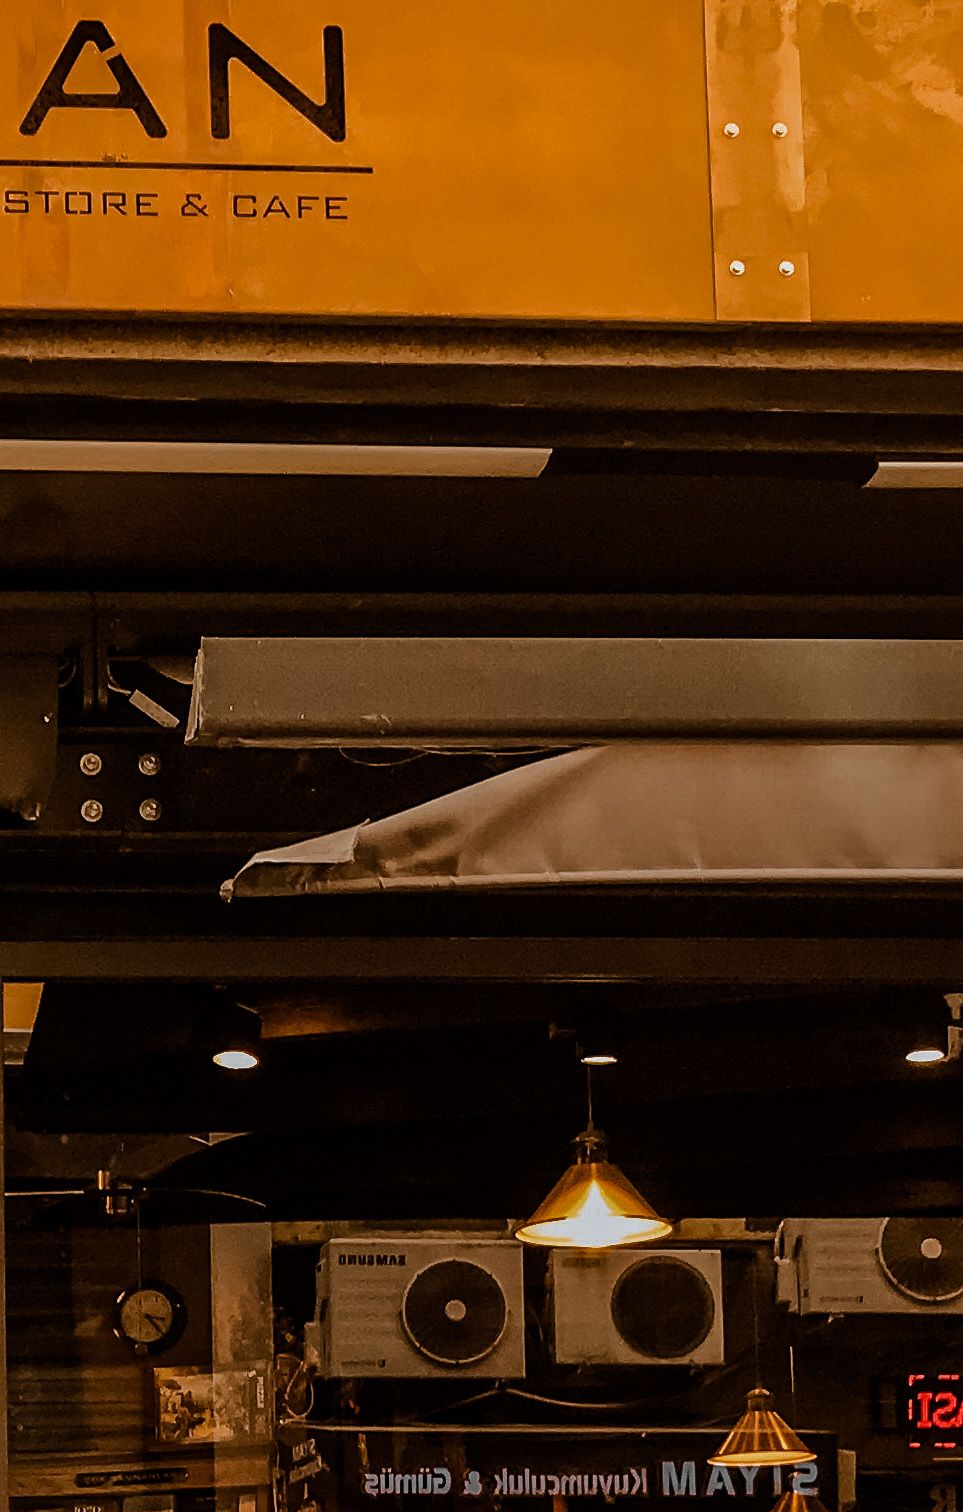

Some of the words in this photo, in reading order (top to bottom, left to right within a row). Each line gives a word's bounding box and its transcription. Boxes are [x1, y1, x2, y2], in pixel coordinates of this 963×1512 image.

[19, 20, 345, 142] AN
[3, 190, 159, 217] STORE
[181, 193, 208, 217] &
[232, 194, 348, 219] CAFE
